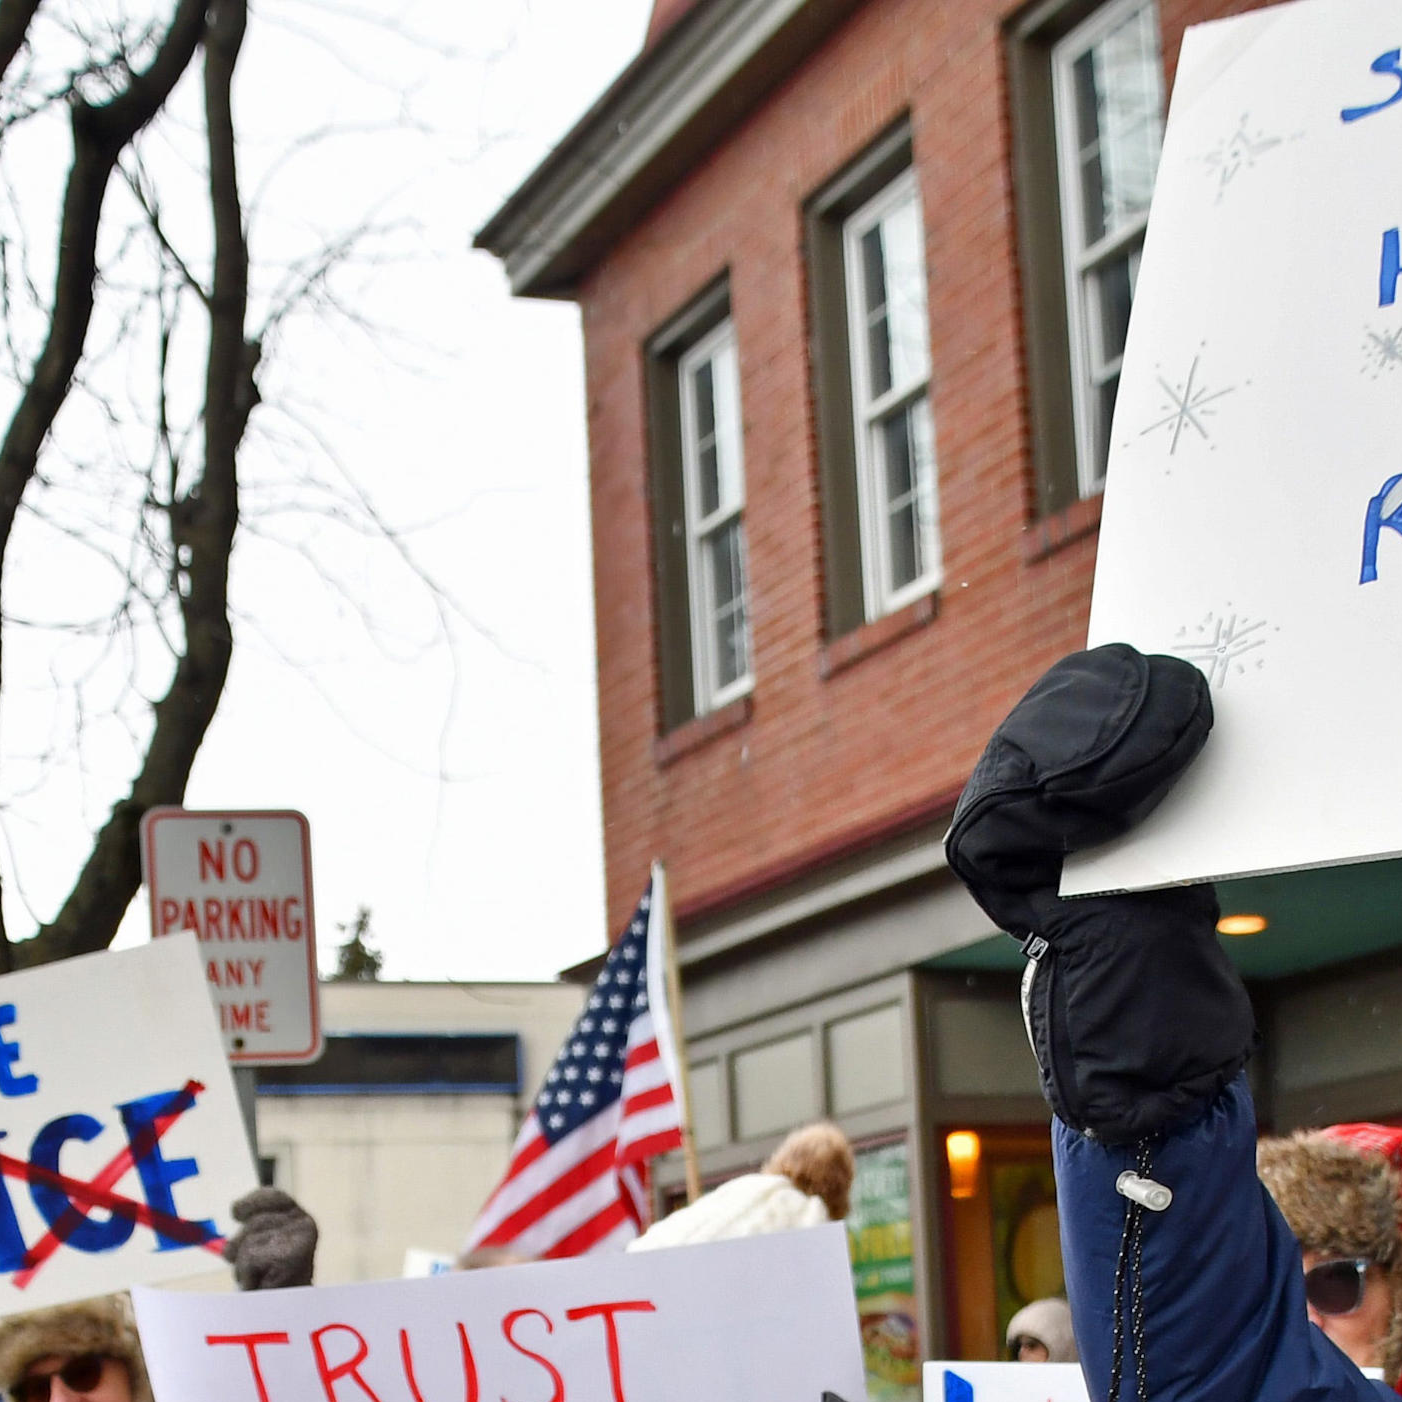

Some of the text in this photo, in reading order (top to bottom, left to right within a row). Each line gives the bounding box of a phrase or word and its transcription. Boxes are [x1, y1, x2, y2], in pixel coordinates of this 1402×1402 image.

[199, 837, 260, 884] NO
[159, 896, 303, 943] PARKING
[206, 956, 265, 989] ANY
[219, 1001, 272, 1034] IME
